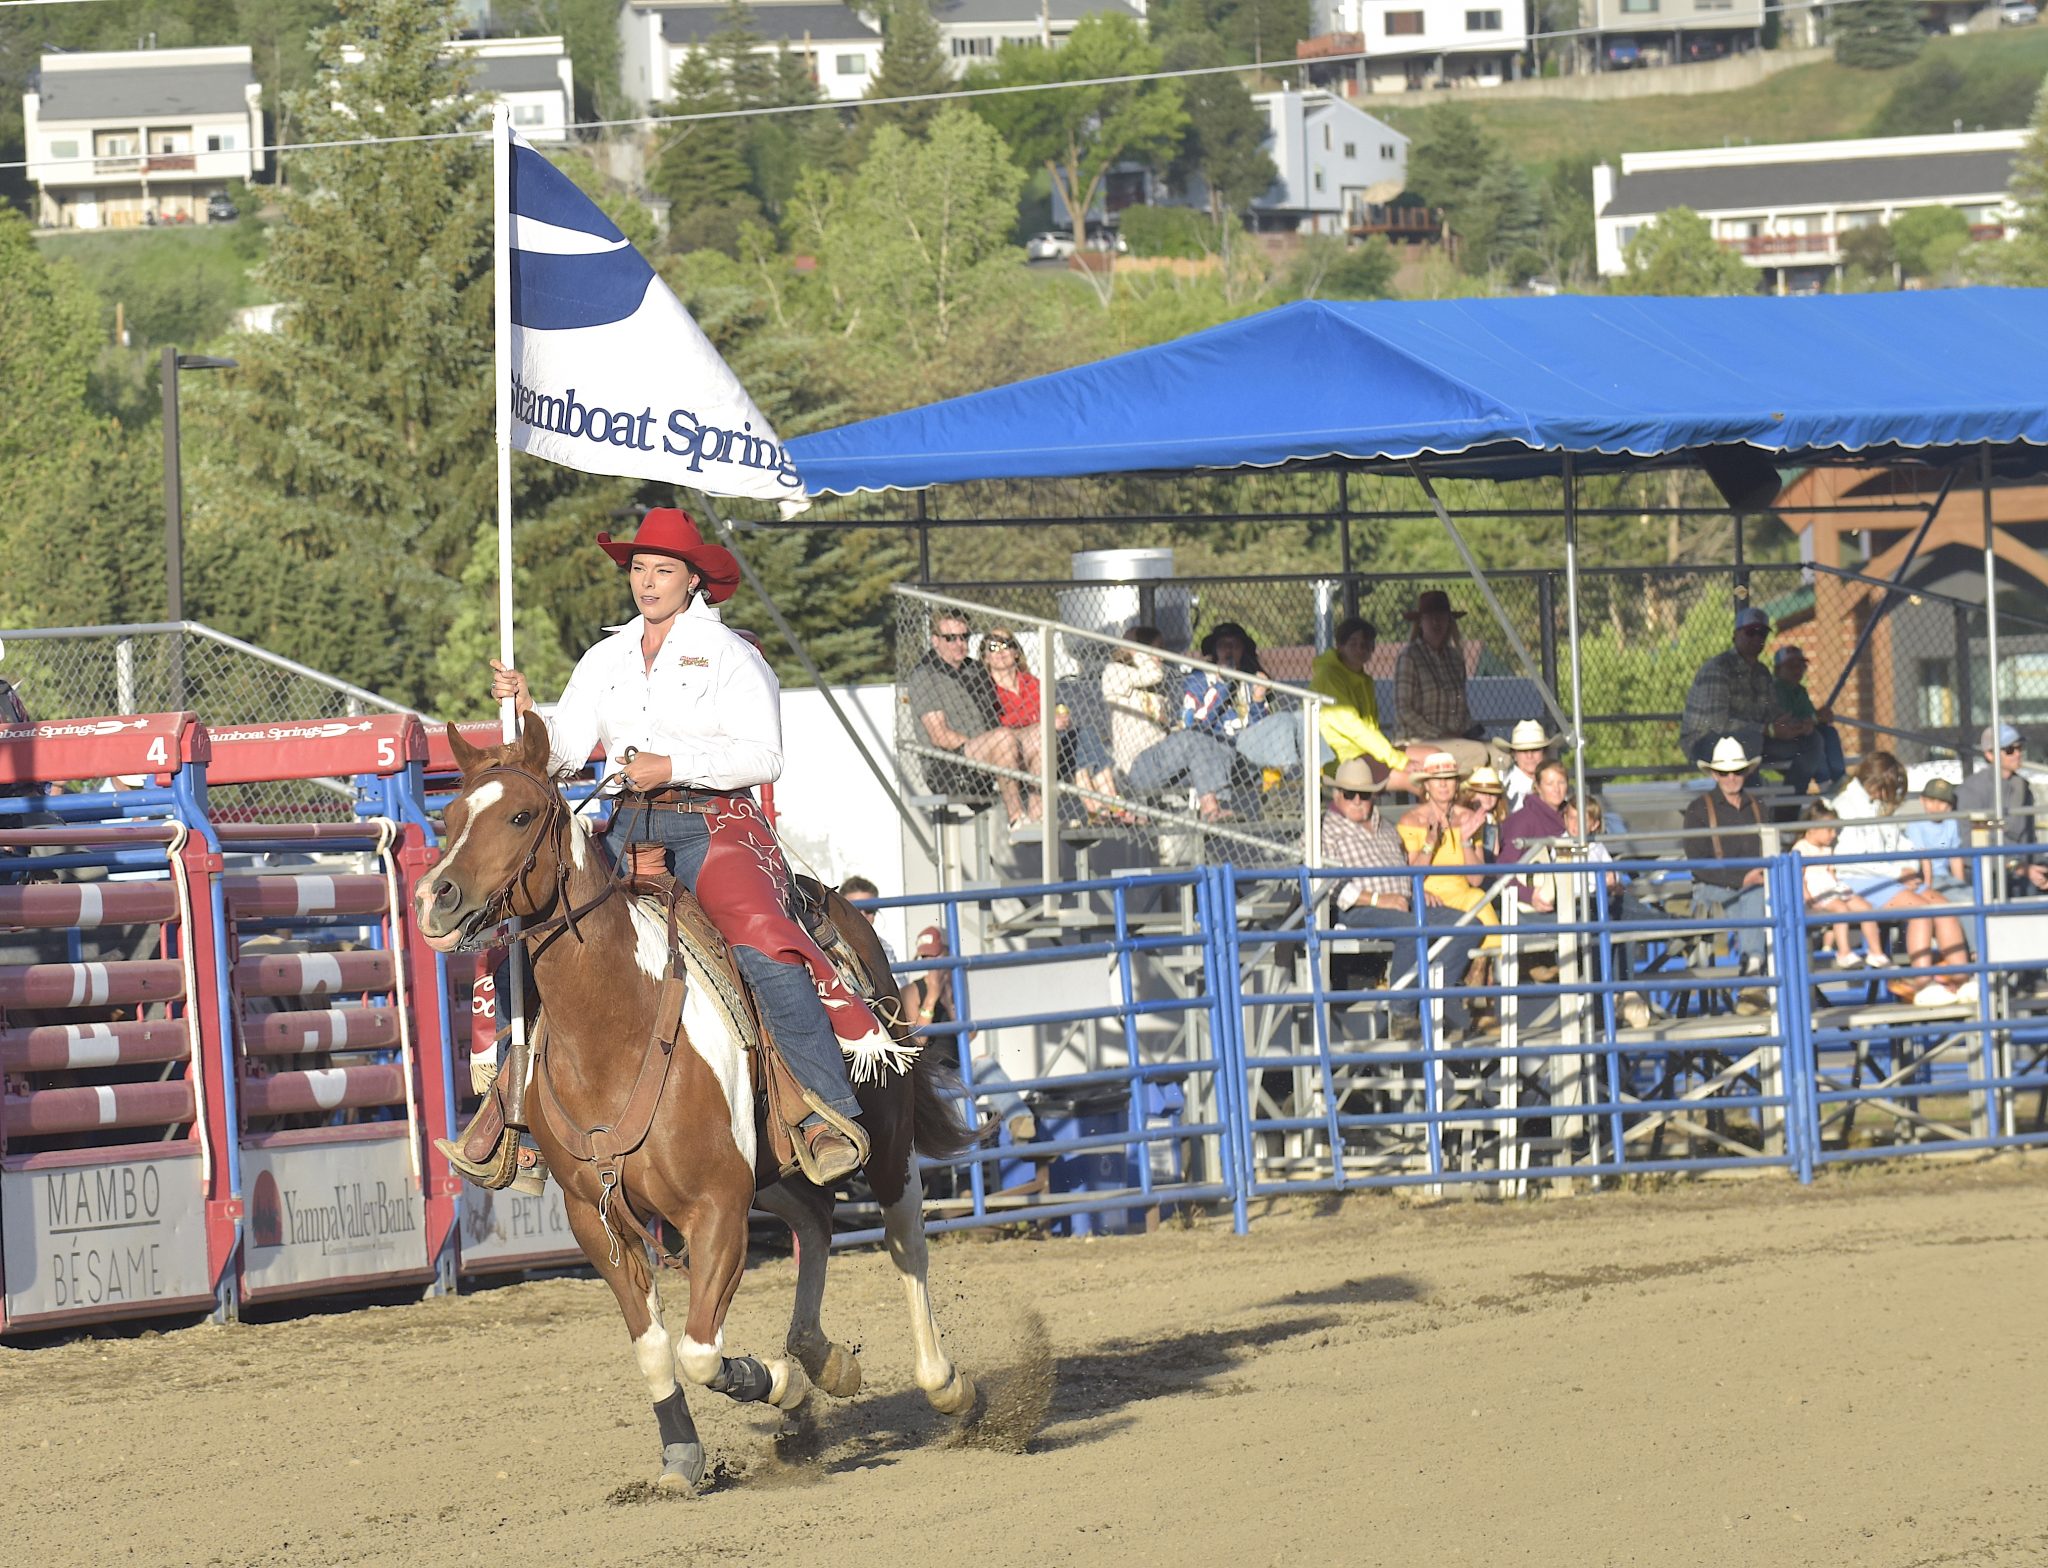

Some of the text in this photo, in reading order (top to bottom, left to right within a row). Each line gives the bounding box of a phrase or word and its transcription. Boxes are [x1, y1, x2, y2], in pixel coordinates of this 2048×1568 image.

[38, 724, 98, 738] Springs
[206, 725, 323, 742] amboat Springs
[146, 736, 169, 766] 4
[377, 737, 396, 767] 5
[47, 1164, 160, 1227] MAMBO
[511, 1194, 545, 1237] PET
[549, 1192, 563, 1232] &
[53, 1235, 162, 1307] BÉSAME
